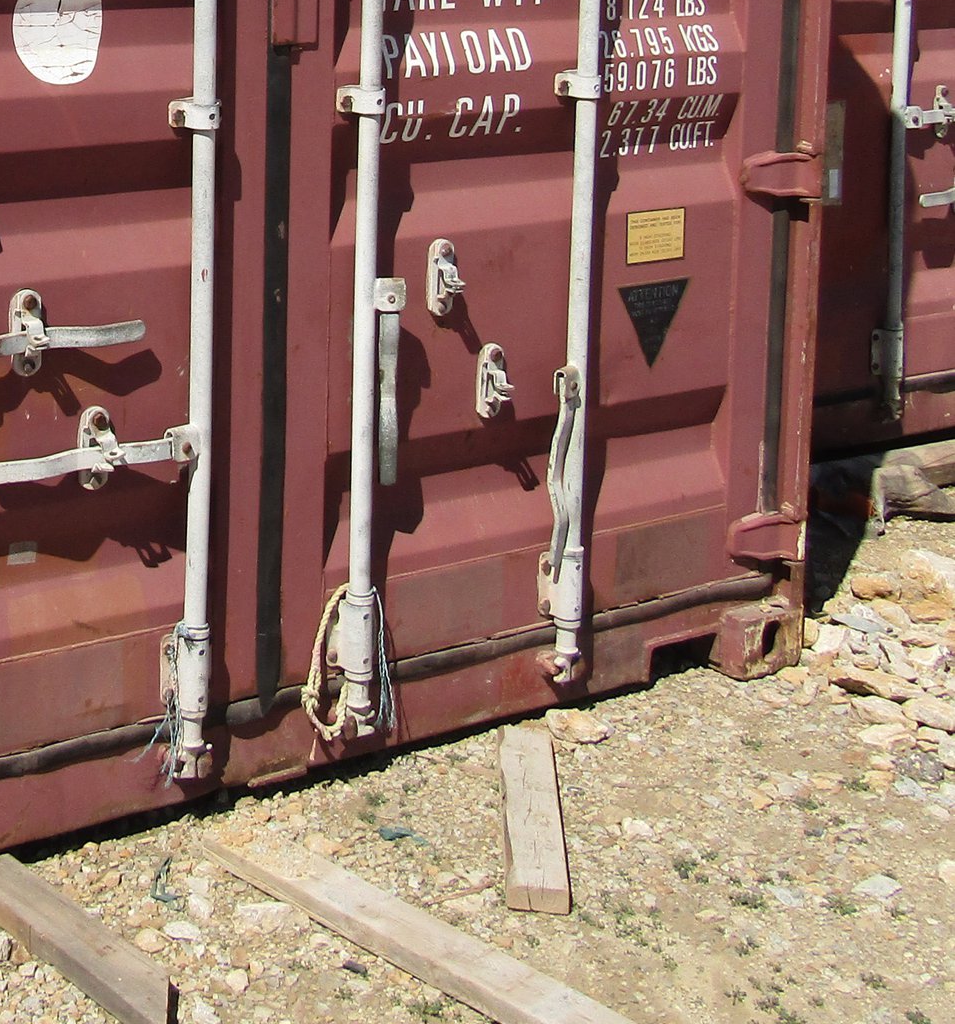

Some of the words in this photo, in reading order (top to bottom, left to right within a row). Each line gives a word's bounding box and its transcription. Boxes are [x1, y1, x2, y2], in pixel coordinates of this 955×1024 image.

[678, 24, 719, 52] KGS
[687, 56, 718, 86] LBS
[448, 94, 522, 138] CAP.
